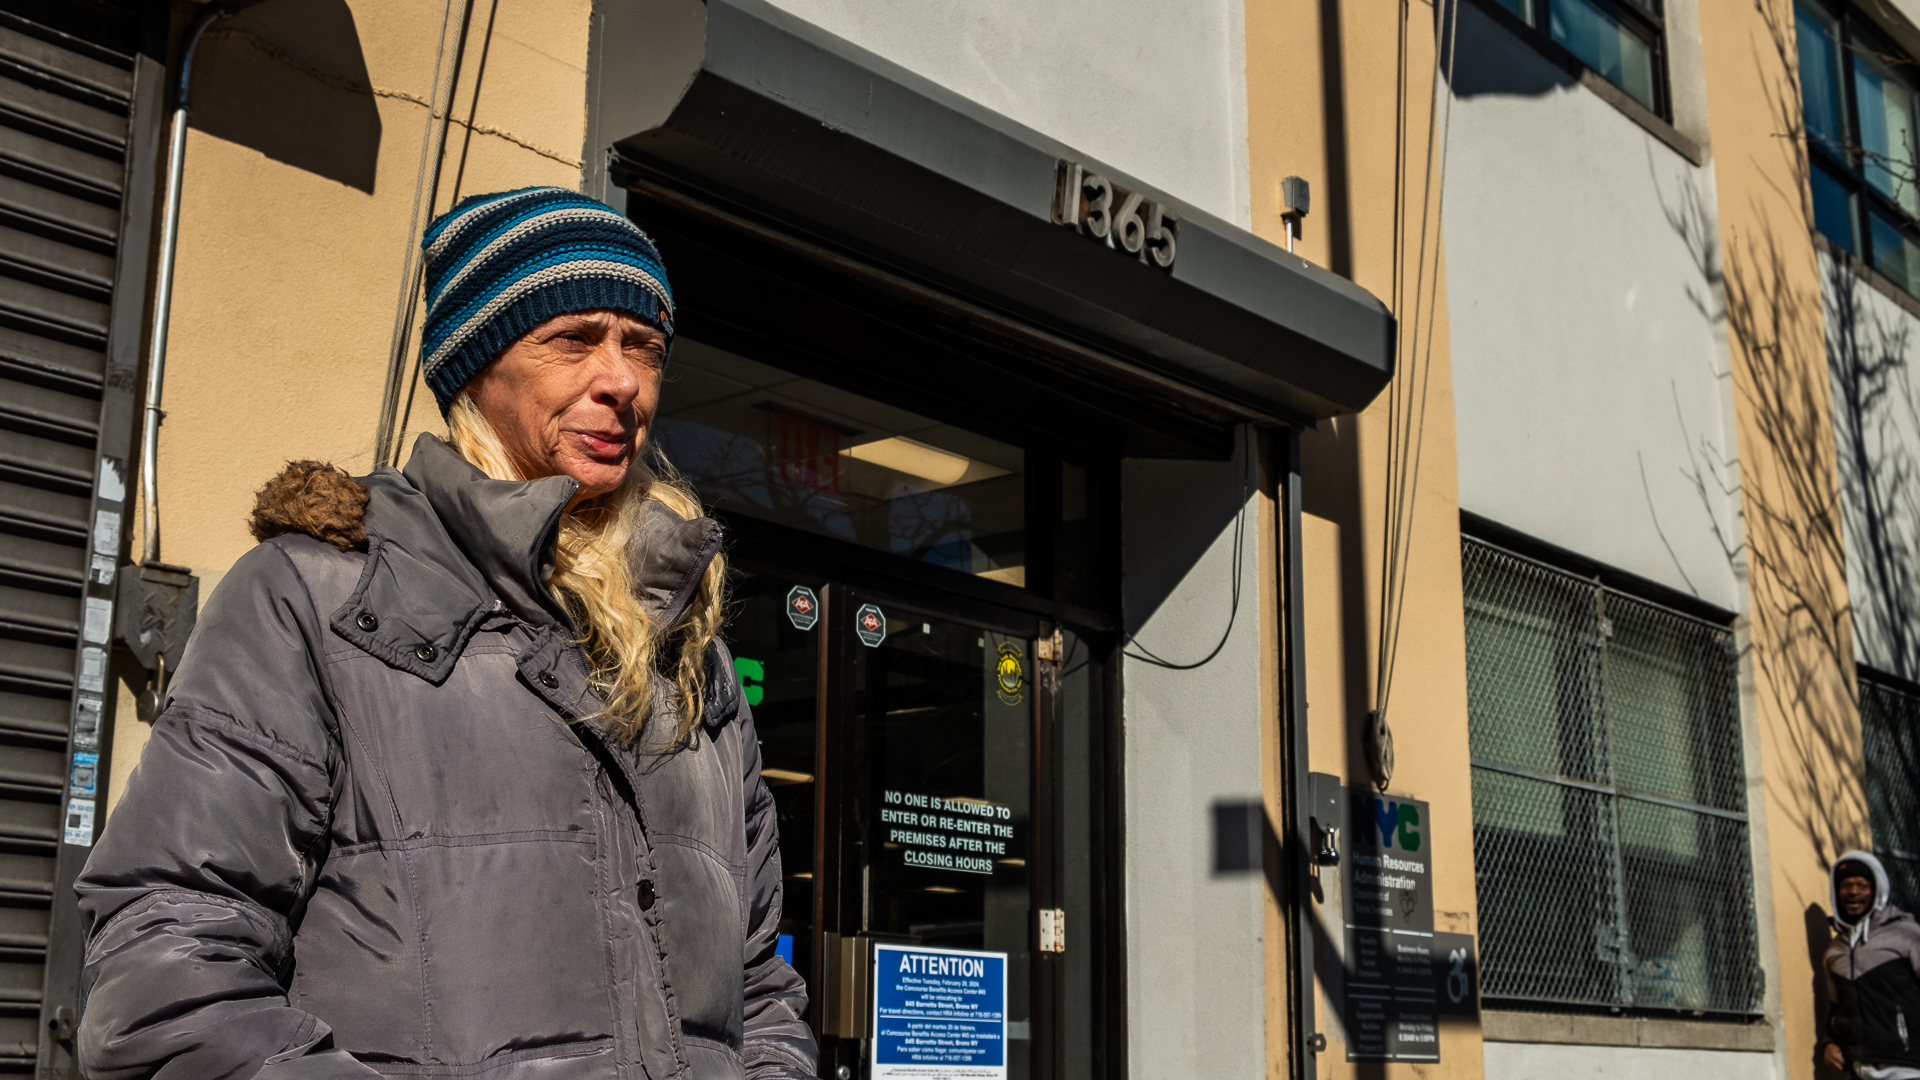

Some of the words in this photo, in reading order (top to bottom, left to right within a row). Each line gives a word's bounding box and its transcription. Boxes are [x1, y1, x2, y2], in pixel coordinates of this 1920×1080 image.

[1055, 160, 1178, 272] 1365
[885, 790, 902, 803] NO
[905, 793, 928, 808] ONE
[931, 797, 941, 810] IS
[944, 800, 994, 817] ALLOWED
[997, 807, 1010, 819] TO
[881, 809, 918, 826] ENTER
[921, 815, 937, 828] OR
[940, 817, 991, 834] RE-ENTER
[993, 824, 1013, 838] THE
[1351, 795, 1420, 852] NYC
[891, 830, 946, 848] PREMISES
[949, 837, 982, 852] AFTER
[985, 841, 1005, 854] THE
[904, 850, 952, 867] CLOSING
[956, 857, 993, 872] HOURS
[1353, 851, 1381, 867] Human
[1383, 855, 1425, 874] Resources
[1354, 870, 1416, 890] Administration
[1384, 893, 1390, 901] of
[900, 954, 984, 978] ATTENTION
[922, 978, 941, 986] Tuesday,
[942, 979, 961, 987] February
[1399, 1023, 1416, 1033] Monday
[1421, 1024, 1434, 1033] Friday
